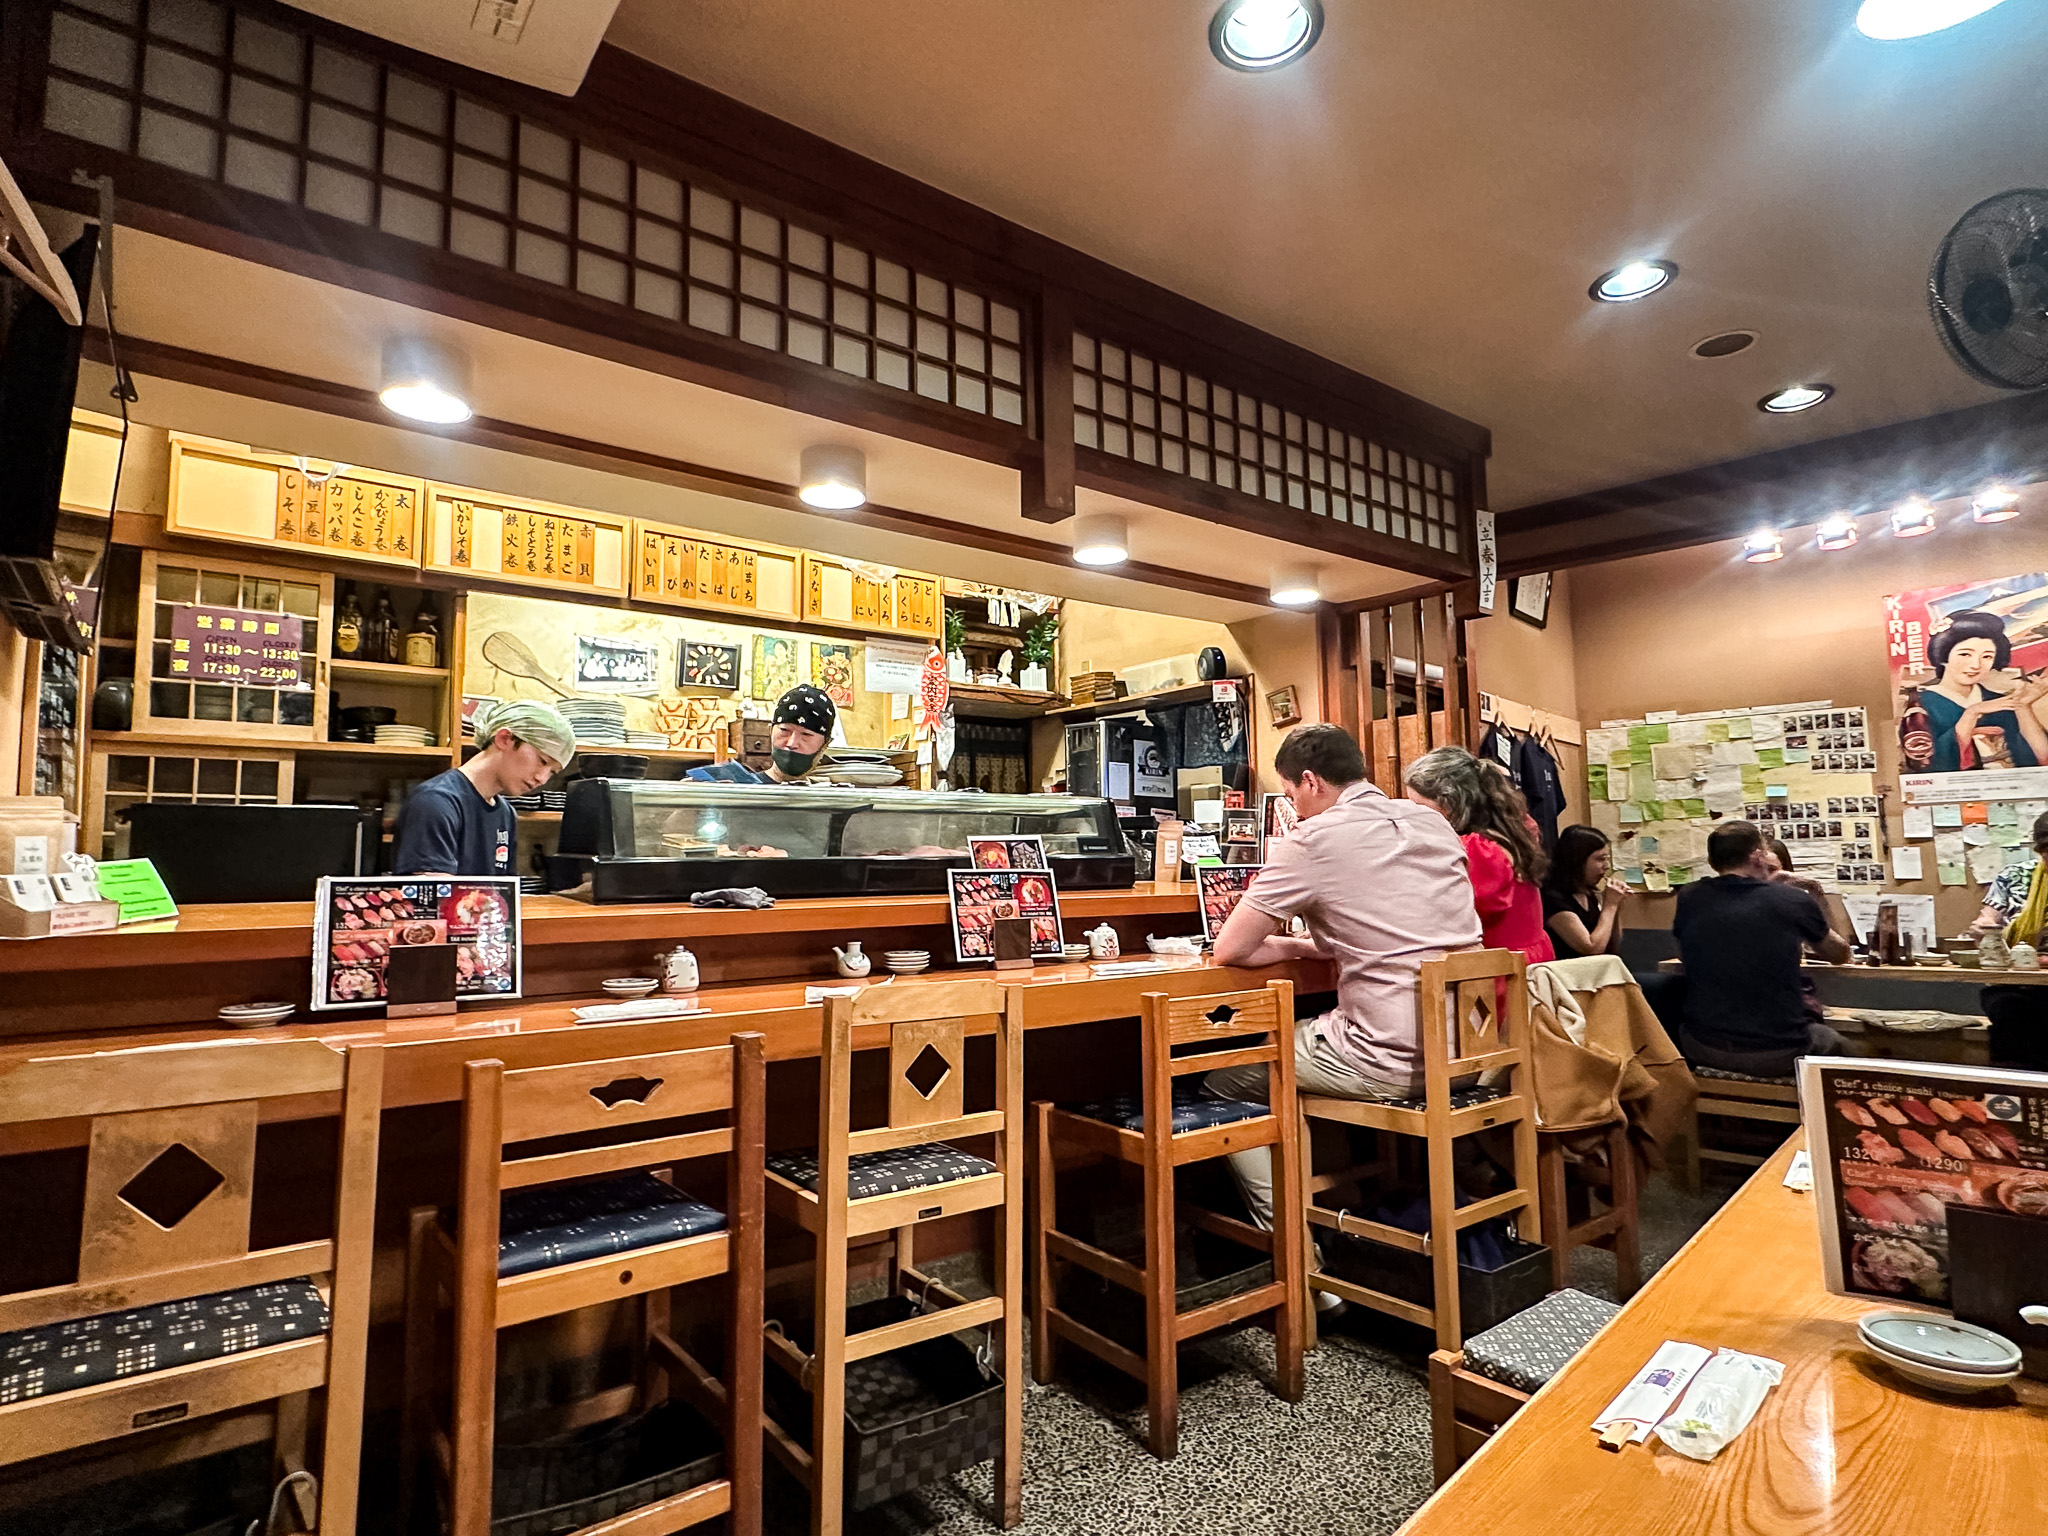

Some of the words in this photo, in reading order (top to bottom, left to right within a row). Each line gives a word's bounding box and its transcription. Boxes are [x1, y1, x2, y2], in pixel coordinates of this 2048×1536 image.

[279, 475, 297, 535] しそ巻
[350, 486, 366, 547] しんこ巻
[393, 493, 411, 552] 太巻
[455, 503, 471, 564] いかしそ巻
[504, 513, 519, 568] 鉄火巻
[526, 514, 537, 572] しそとろ巻
[561, 522, 574, 575] たまご
[579, 524, 592, 577] 赤貝
[645, 537, 658, 588] ばい貝
[667, 541, 678, 590] えび
[682, 543, 695, 590] いか
[699, 546, 710, 594] たこ
[713, 548, 725, 596] さば
[729, 551, 740, 600] あじ
[744, 553, 754, 602] はまち
[1480, 527, 1495, 603] 立春大吉
[811, 563, 820, 612] うなぎ
[855, 575, 865, 616] かに
[899, 579, 908, 623] いくら
[912, 581, 921, 624] うに
[924, 585, 933, 628] とろ
[206, 635, 238, 644] OPEN
[263, 640, 297, 649] CLOSED
[1886, 595, 1907, 657] KIRIN
[1906, 620, 1925, 676] BEER
[204, 655, 235, 664] OPEN
[1872, 1082, 1902, 1092] choice
[1906, 1086, 1933, 1096] sushi
